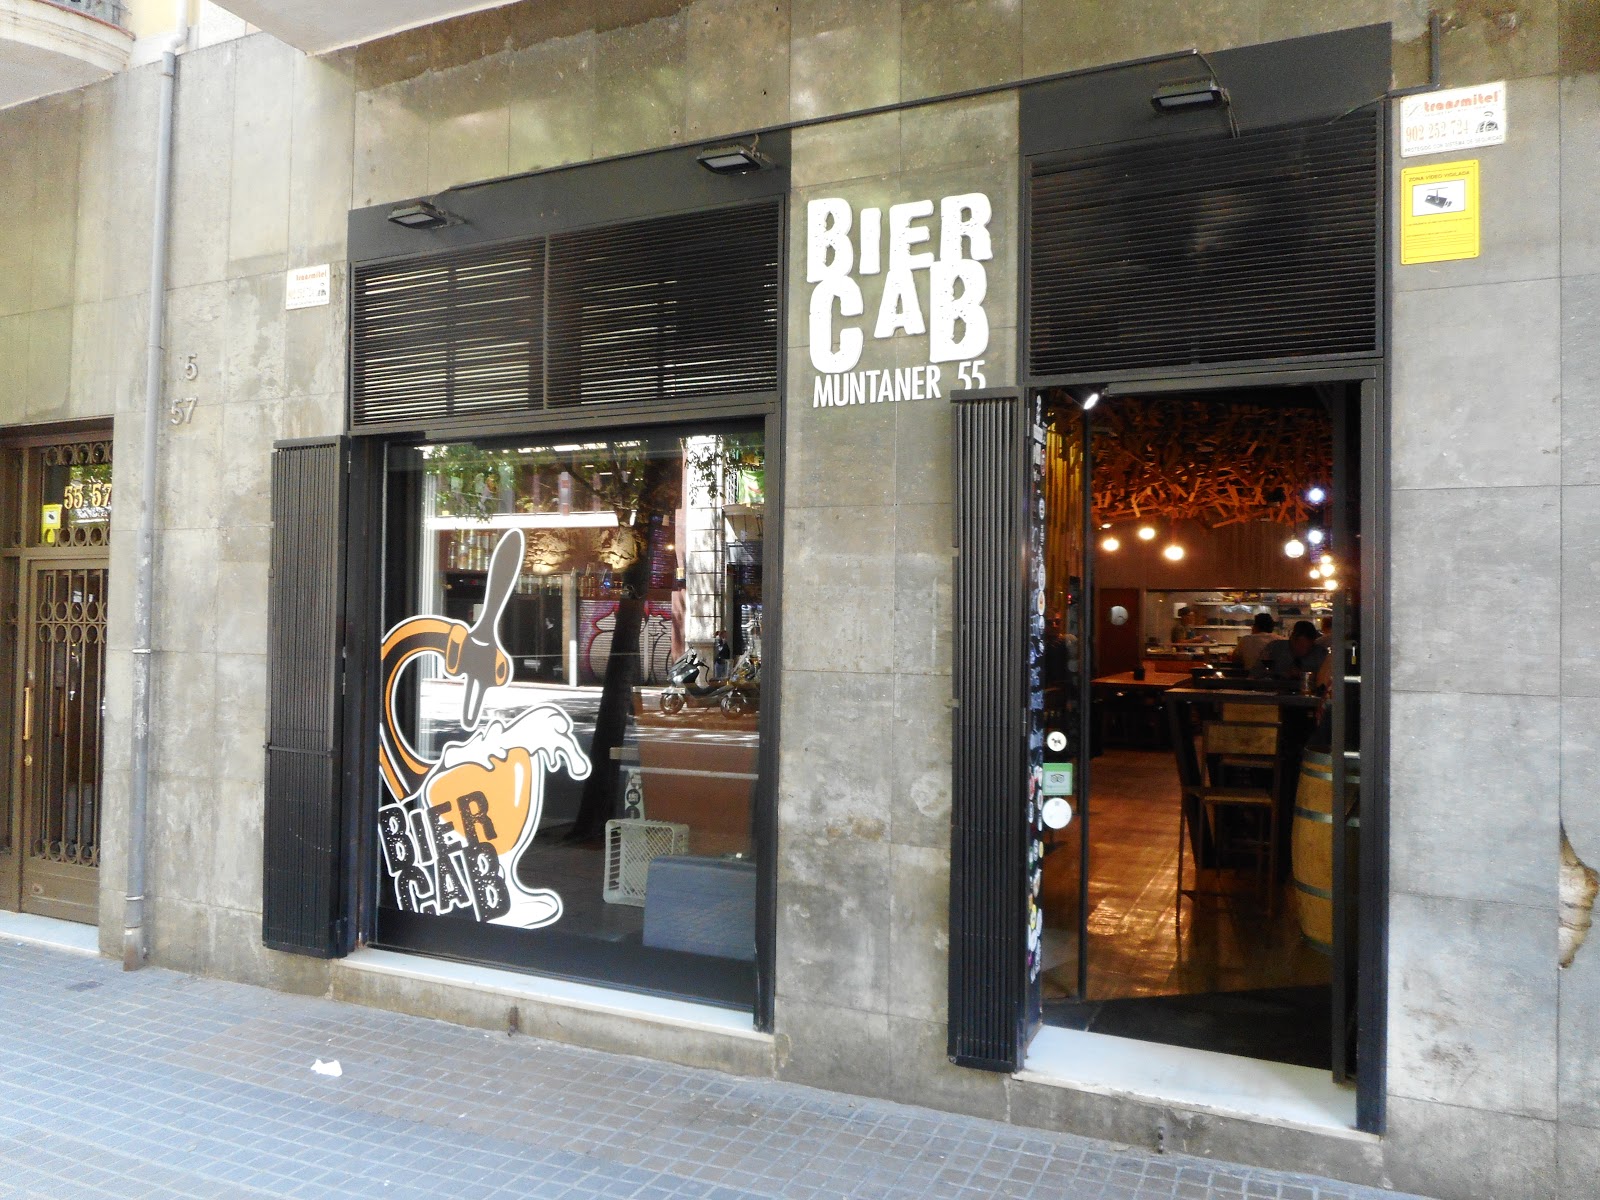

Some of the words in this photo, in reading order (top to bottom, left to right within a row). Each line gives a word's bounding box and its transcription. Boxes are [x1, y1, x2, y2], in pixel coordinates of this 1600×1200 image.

[1424, 90, 1499, 113] transmitel
[1406, 124, 1425, 143] 902
[1428, 121, 1447, 140] 252
[807, 193, 993, 283] BIER
[809, 258, 990, 374] CAB
[812, 364, 942, 408] MUNTANER
[957, 359, 986, 390] 55
[171, 396, 199, 425] 57
[64, 485, 83, 509] 55
[92, 483, 112, 507] 57
[378, 790, 498, 877] BIER
[395, 841, 512, 923] CAB
